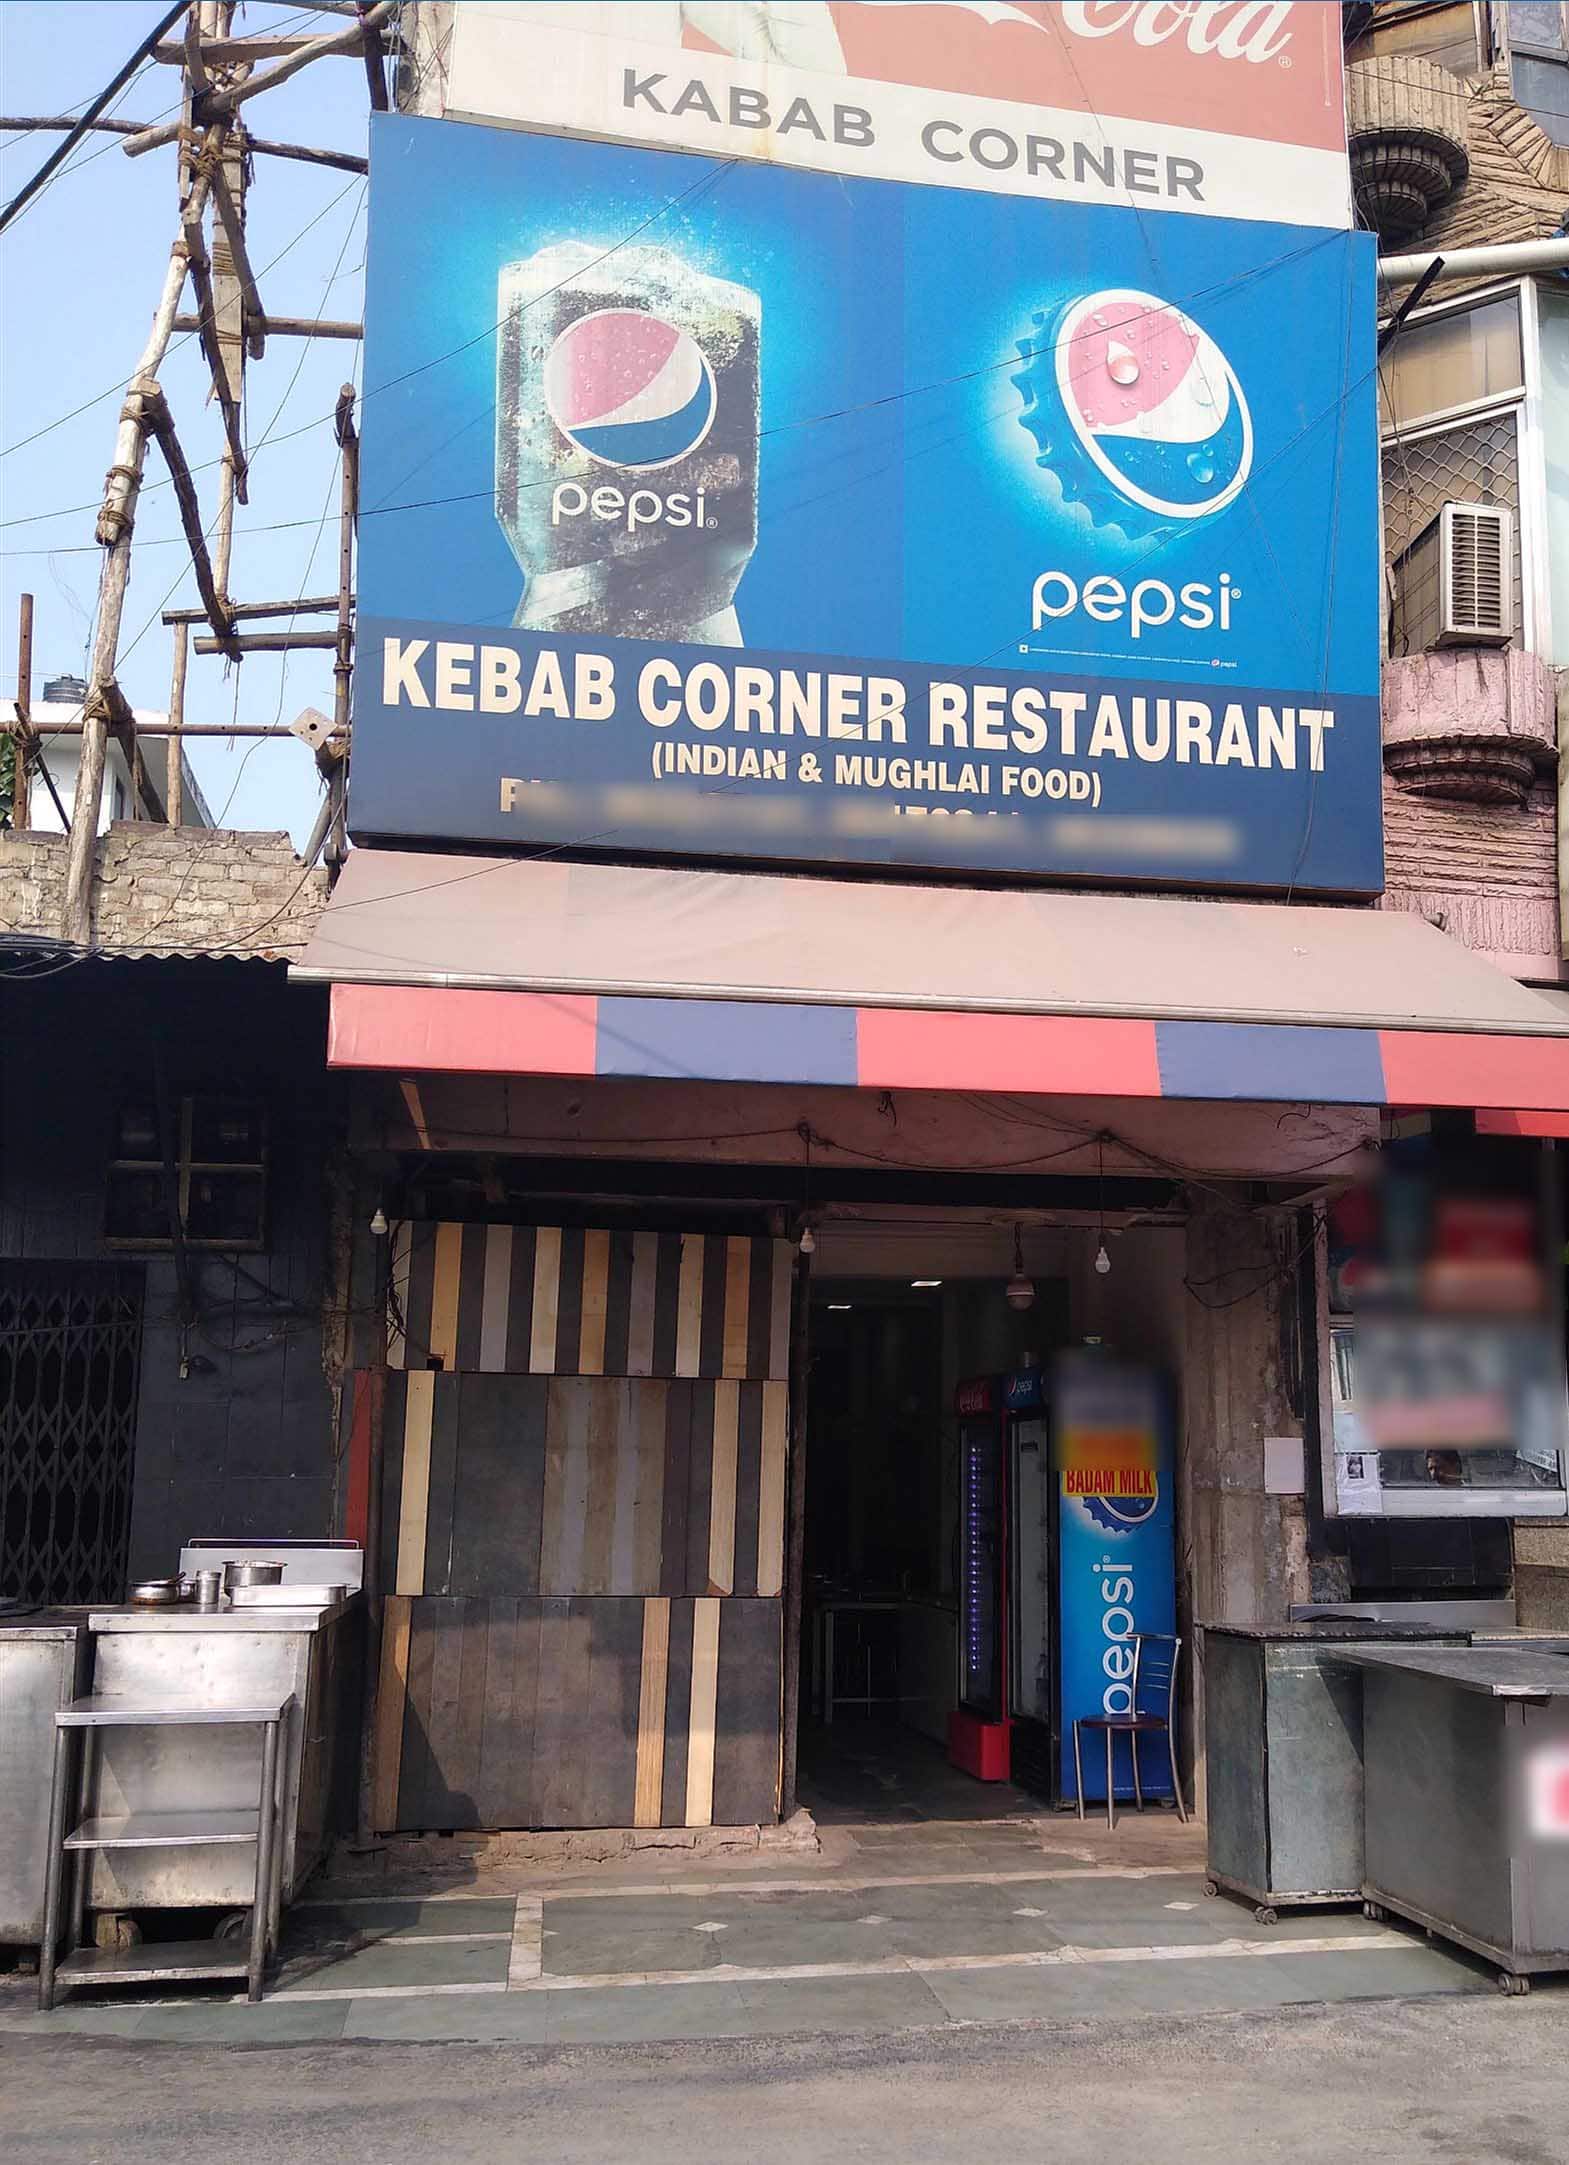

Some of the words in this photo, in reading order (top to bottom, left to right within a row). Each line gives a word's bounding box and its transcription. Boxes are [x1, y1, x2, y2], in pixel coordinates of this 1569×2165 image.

[622, 68, 876, 148] KABAB
[921, 119, 1206, 202] CORNER
[552, 482, 706, 533] pepsi
[1031, 570, 1232, 638] pepsi
[382, 637, 616, 721] KEBAB
[637, 658, 907, 744] CORNER
[928, 682, 1335, 773] RESTAURANT
[652, 741, 787, 781] (INDIAN
[798, 752, 823, 783] &
[834, 754, 990, 795] MUGHLAI
[1002, 767, 1102, 808] FOOD)
[1120, 1470, 1153, 1494] MILK
[1093, 1563, 1146, 1714] pepsi
